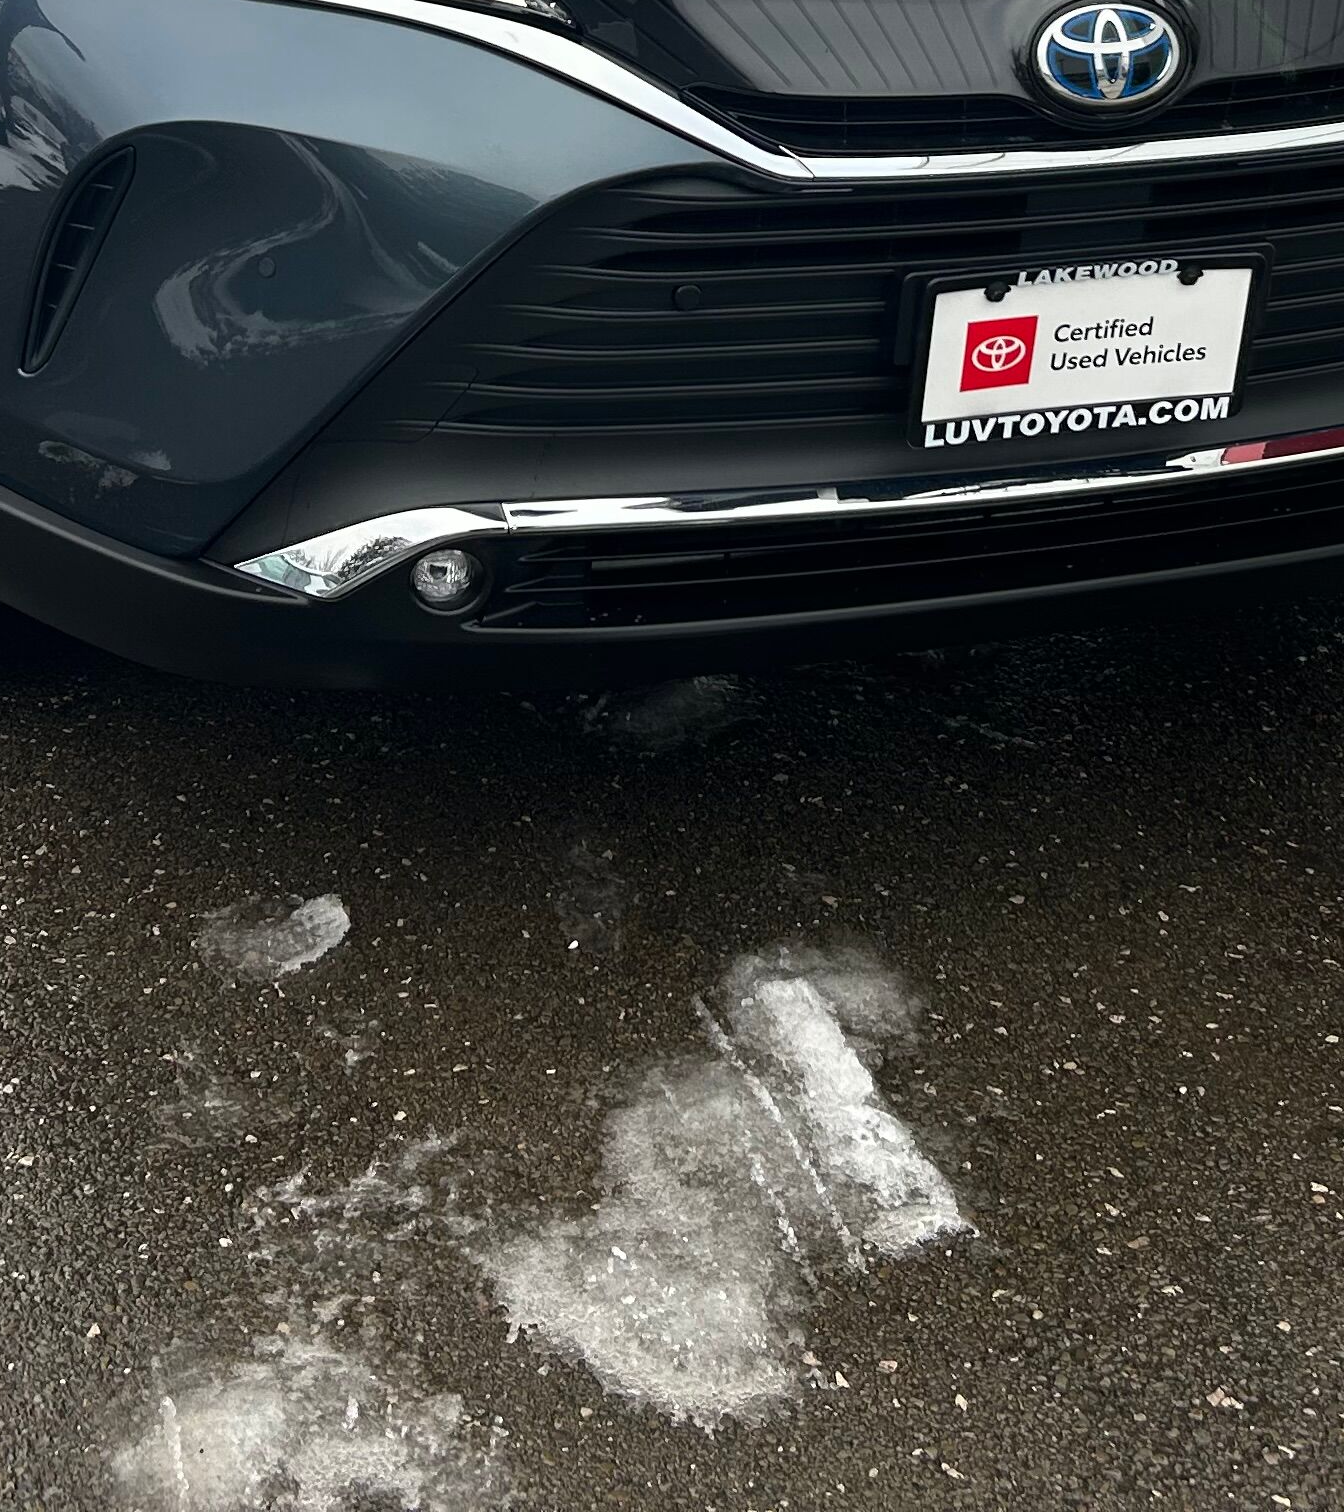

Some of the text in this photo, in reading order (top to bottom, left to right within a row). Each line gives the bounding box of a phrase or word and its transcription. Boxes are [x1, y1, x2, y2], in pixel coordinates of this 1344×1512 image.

[1017, 259, 1179, 287] LAKEWOOD
[1053, 316, 1154, 343] Certified
[1050, 342, 1207, 371] Used Vehicles
[923, 396, 1230, 449] LUVTOYOTA.COM
